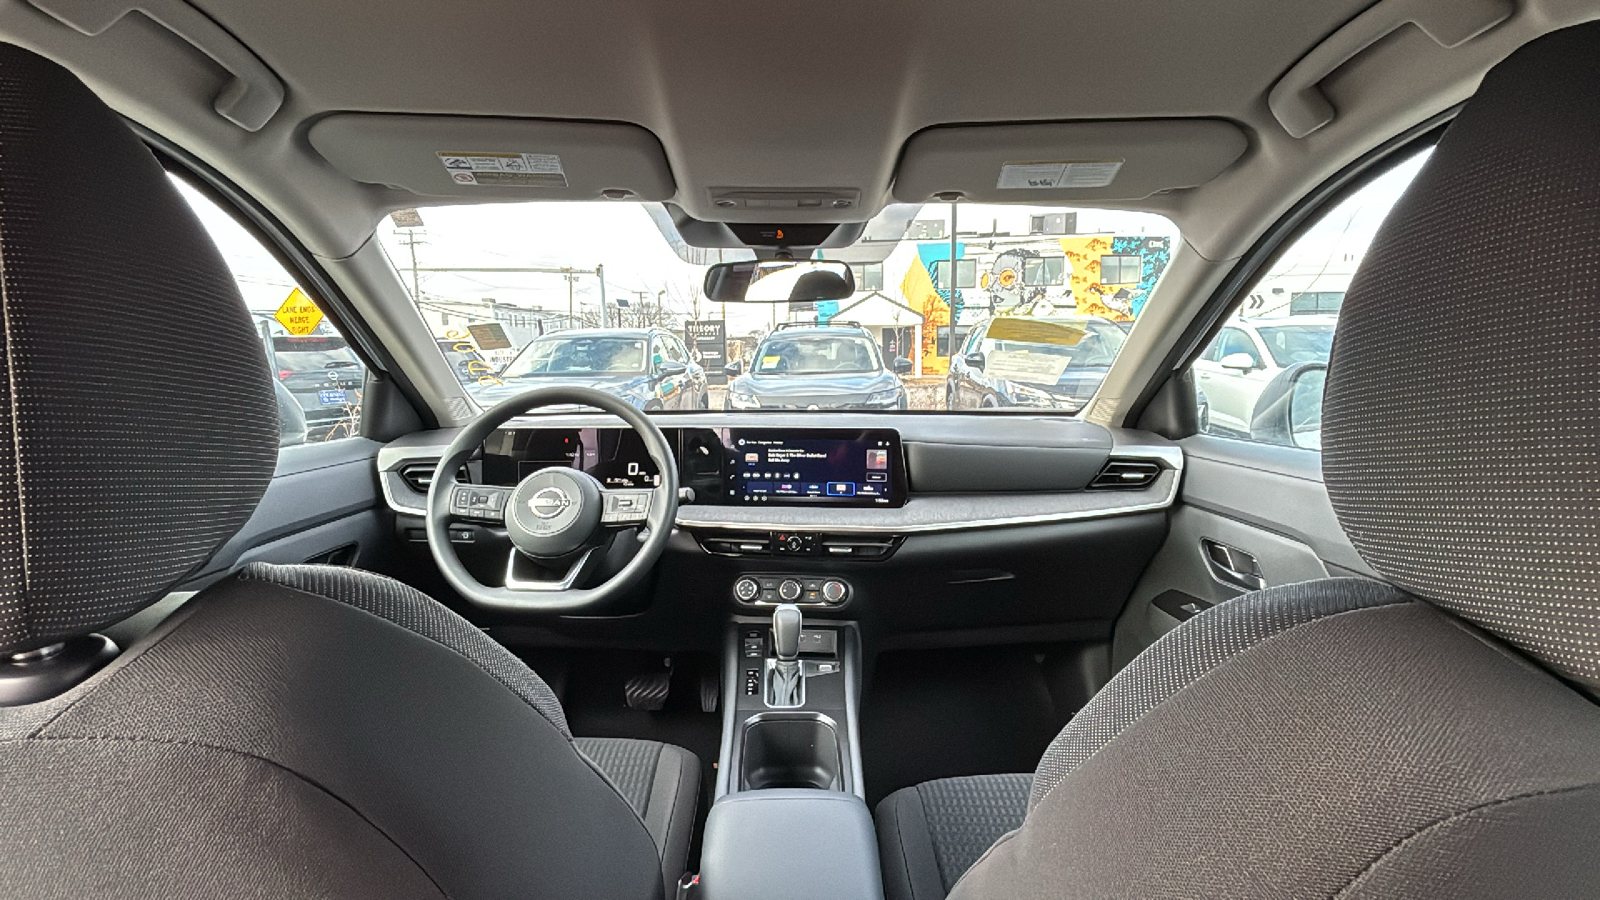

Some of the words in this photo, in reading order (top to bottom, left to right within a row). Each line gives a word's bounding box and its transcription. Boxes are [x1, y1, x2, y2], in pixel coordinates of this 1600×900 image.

[282, 306, 297, 314] LANE
[299, 306, 316, 314] ENDS
[289, 316, 310, 324] MERGE
[291, 326, 310, 334] RIGHT
[688, 324, 721, 334] THEORY
[627, 463, 639, 476] 0
